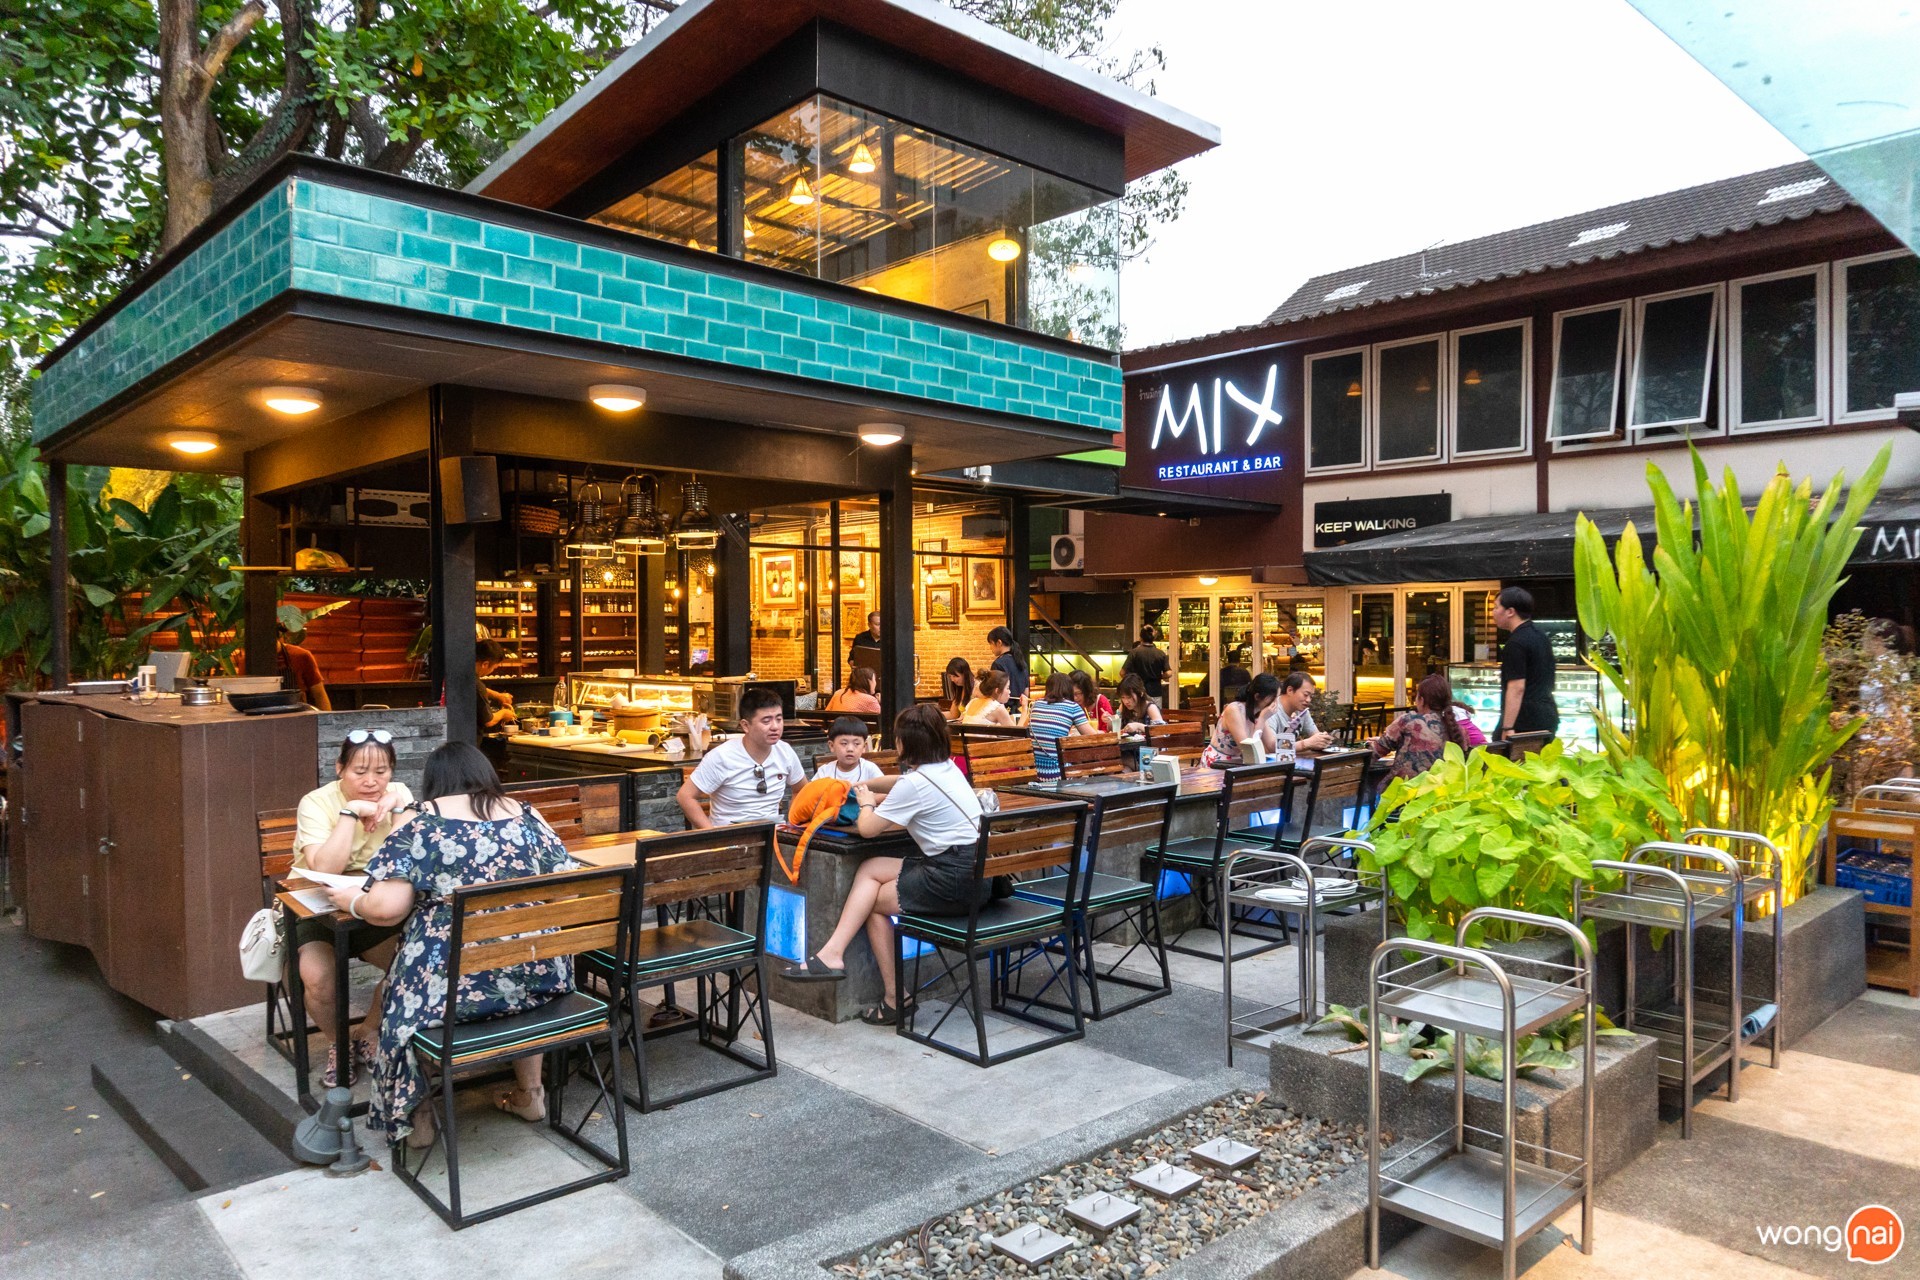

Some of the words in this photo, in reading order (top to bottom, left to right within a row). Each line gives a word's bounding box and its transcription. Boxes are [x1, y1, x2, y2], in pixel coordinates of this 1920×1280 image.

[1151, 364, 1283, 455] MIX
[1159, 459, 1239, 479] RESTAURANT
[1242, 459, 1251, 472] &
[1255, 456, 1282, 470] BAR
[1315, 521, 1353, 534] KEEP
[1354, 517, 1417, 532] WALKING
[1871, 525, 1920, 559] MI
